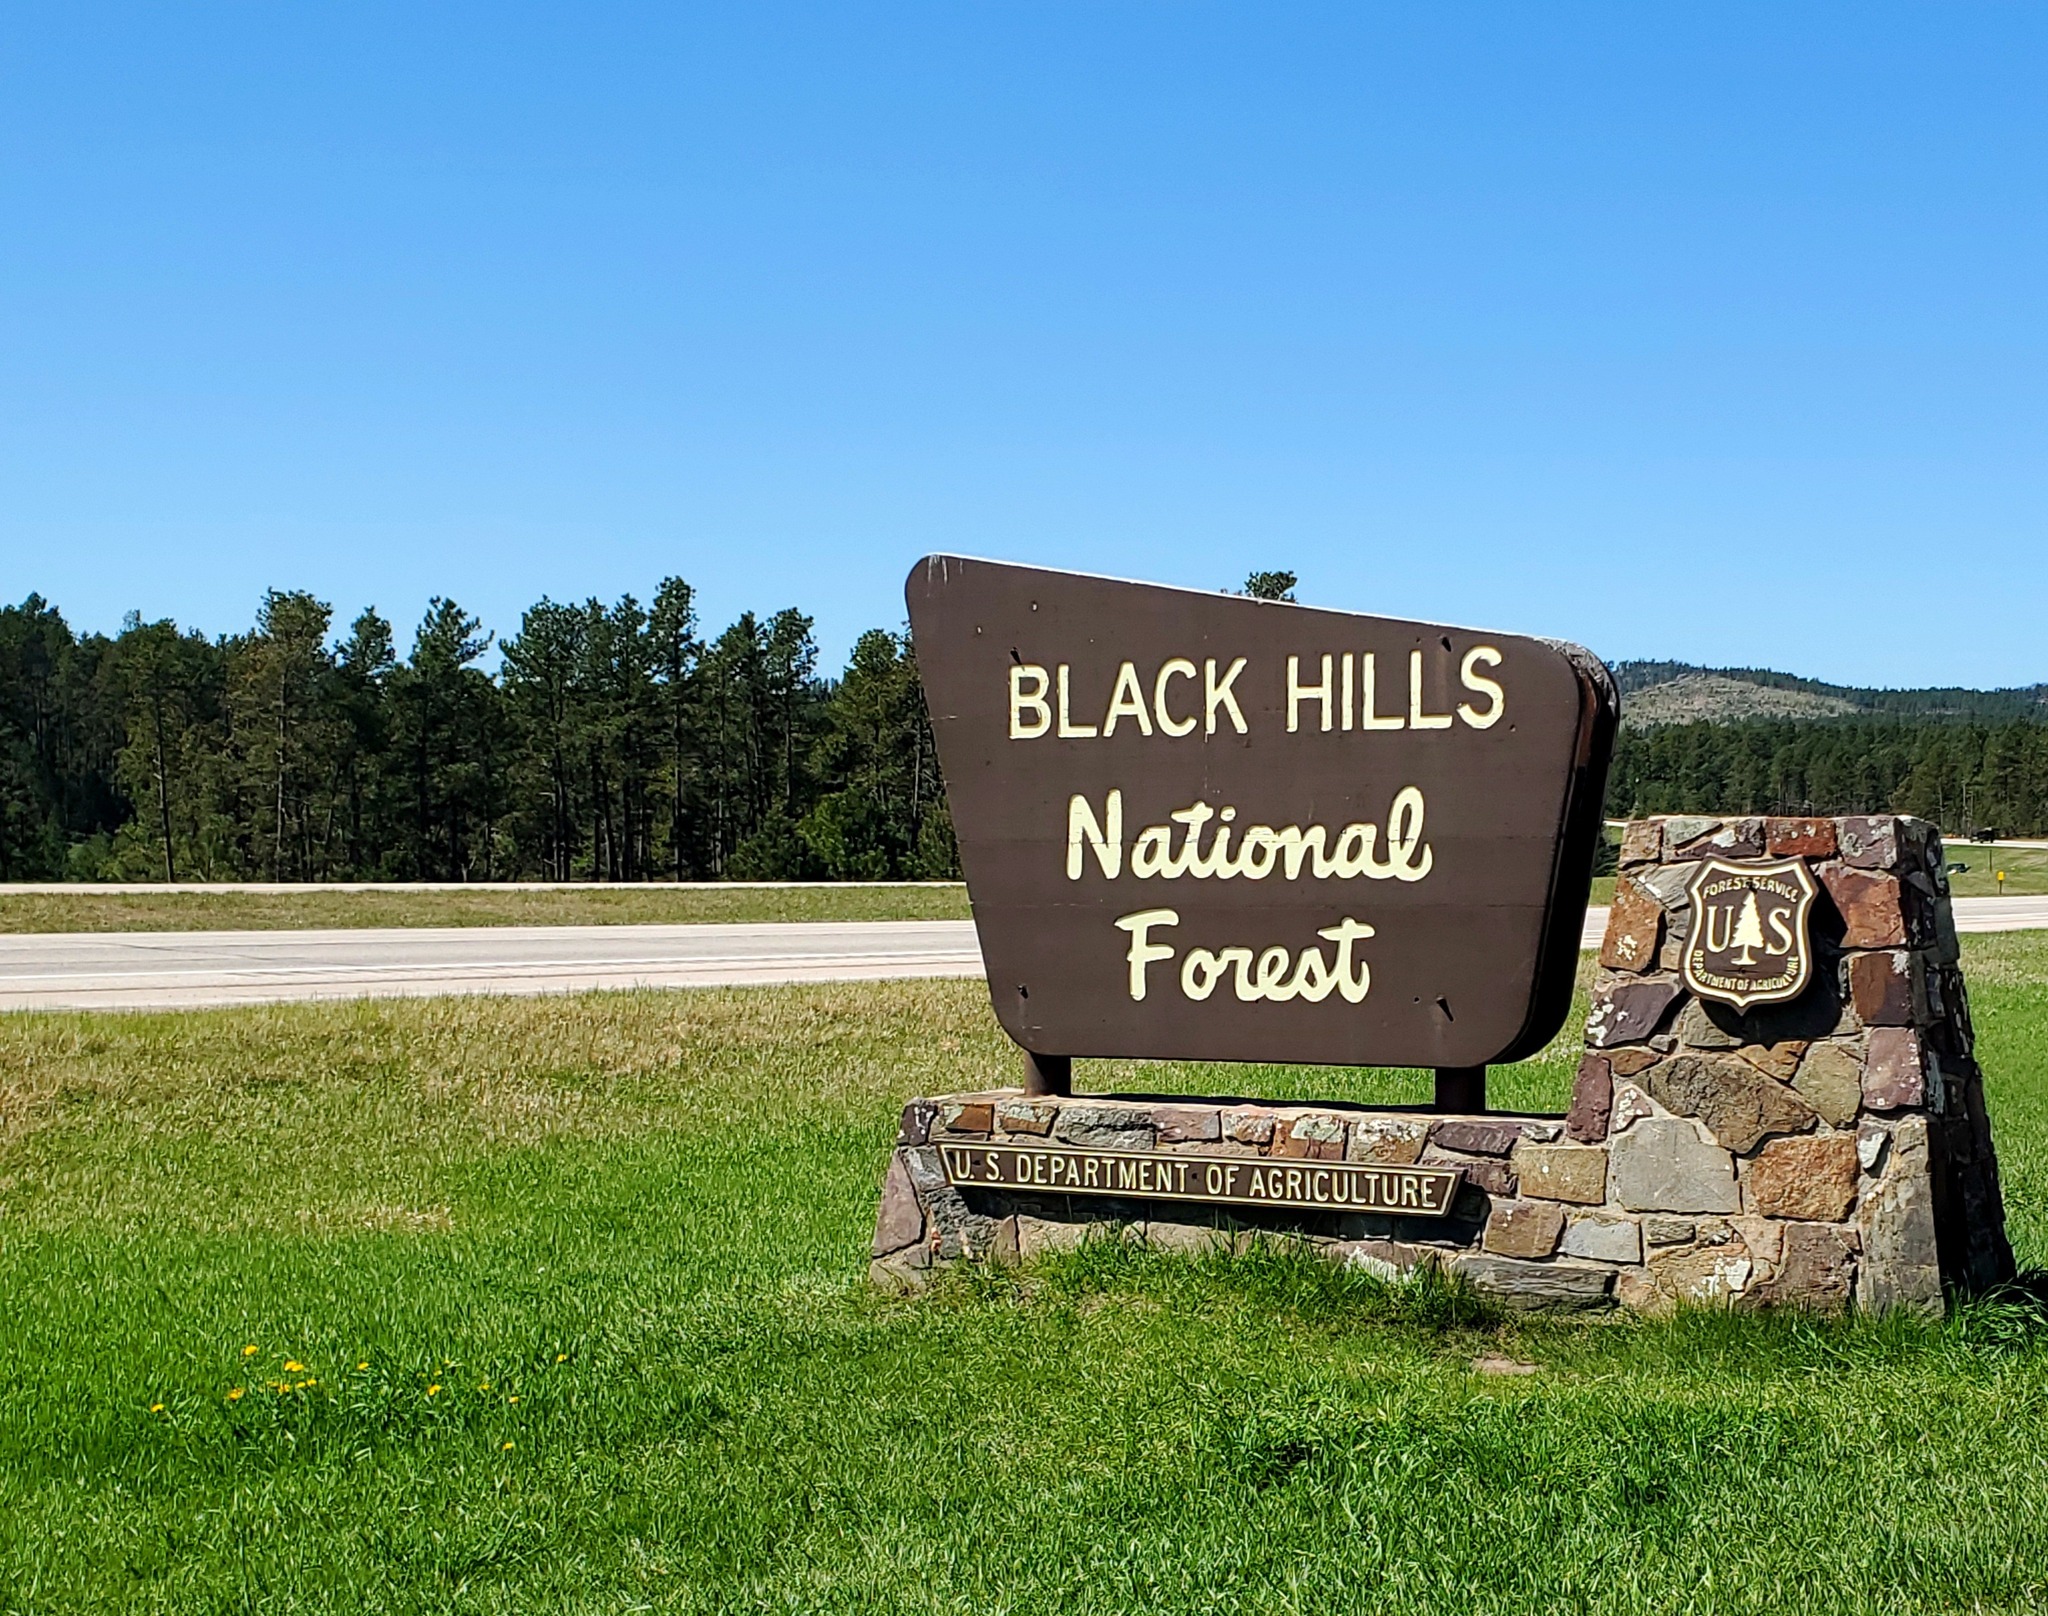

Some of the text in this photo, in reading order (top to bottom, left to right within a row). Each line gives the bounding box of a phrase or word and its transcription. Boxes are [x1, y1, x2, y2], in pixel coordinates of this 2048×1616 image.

[1009, 645, 1505, 739] BLACK HILLS
[1066, 787, 1433, 881] National
[1702, 877, 1798, 903] FOREST SERVICE
[1114, 908, 1375, 1004] Forest
[1692, 950, 1737, 990] DEPARTMENT
[1737, 979, 1750, 991] OF
[1016, 1153, 1190, 1193] DEPARTMENT
[1206, 1164, 1240, 1196] OF
[1249, 1168, 1437, 1208] AGRICULTURE
